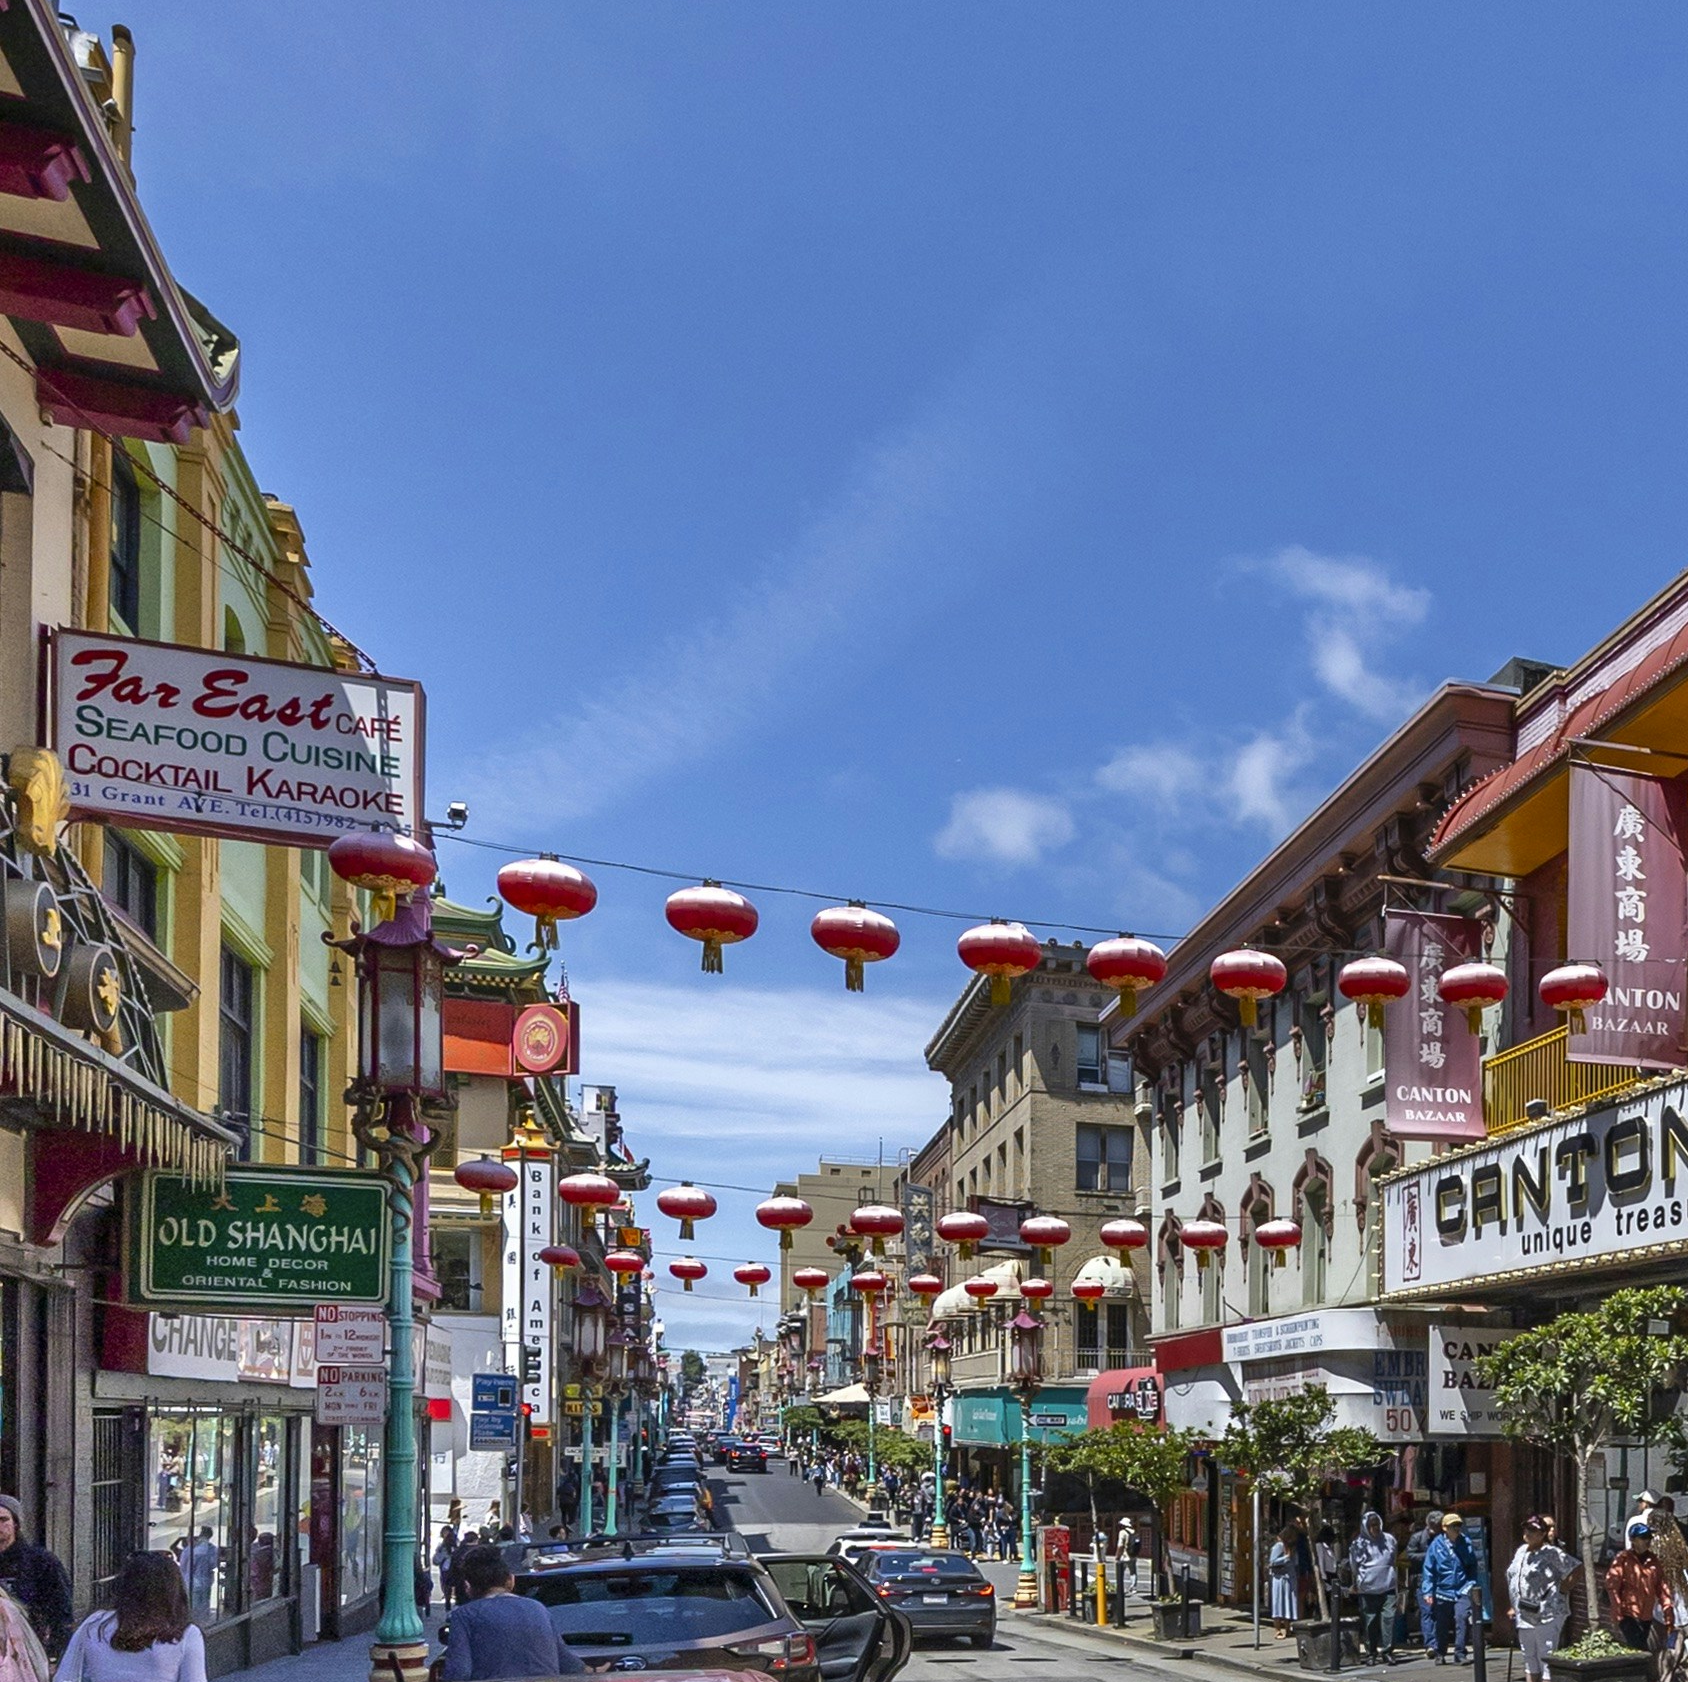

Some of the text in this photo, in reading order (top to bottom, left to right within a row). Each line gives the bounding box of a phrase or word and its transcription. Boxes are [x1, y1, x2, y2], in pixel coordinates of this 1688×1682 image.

[71, 650, 403, 743] Far East CAFÉ
[75, 704, 401, 779] SEAFOOD CUISINE
[68, 743, 404, 816] COCKTAIL KARAOKE
[71, 782, 91, 797] 31
[102, 786, 166, 806] Grant
[1613, 804, 1650, 963] 廣東商場
[1599, 987, 1680, 1011] ANTON
[1592, 1016, 1670, 1036] BAZAAR
[1397, 1085, 1472, 1105] CANTON
[1405, 1109, 1467, 1123] BAZAAR
[158, 1217, 377, 1256] OLD SHANGHAI
[1521, 1221, 1592, 1257] unique
[206, 1255, 329, 1271] HOME DECOR
[181, 1275, 352, 1292] ORIENTAL FASHION
[261, 1268, 274, 1279] &
[530, 1170, 543, 1414] Bank of Ameca
[318, 1306, 384, 1322] NO STOPPING
[151, 1315, 238, 1362] CHANGE
[320, 1367, 384, 1383] NO PARKING
[363, 1401, 378, 1412] FRI
[566, 1403, 598, 1414] KITS
[1440, 1410, 1456, 1421] WE
[1460, 1410, 1483, 1422] SHIP
